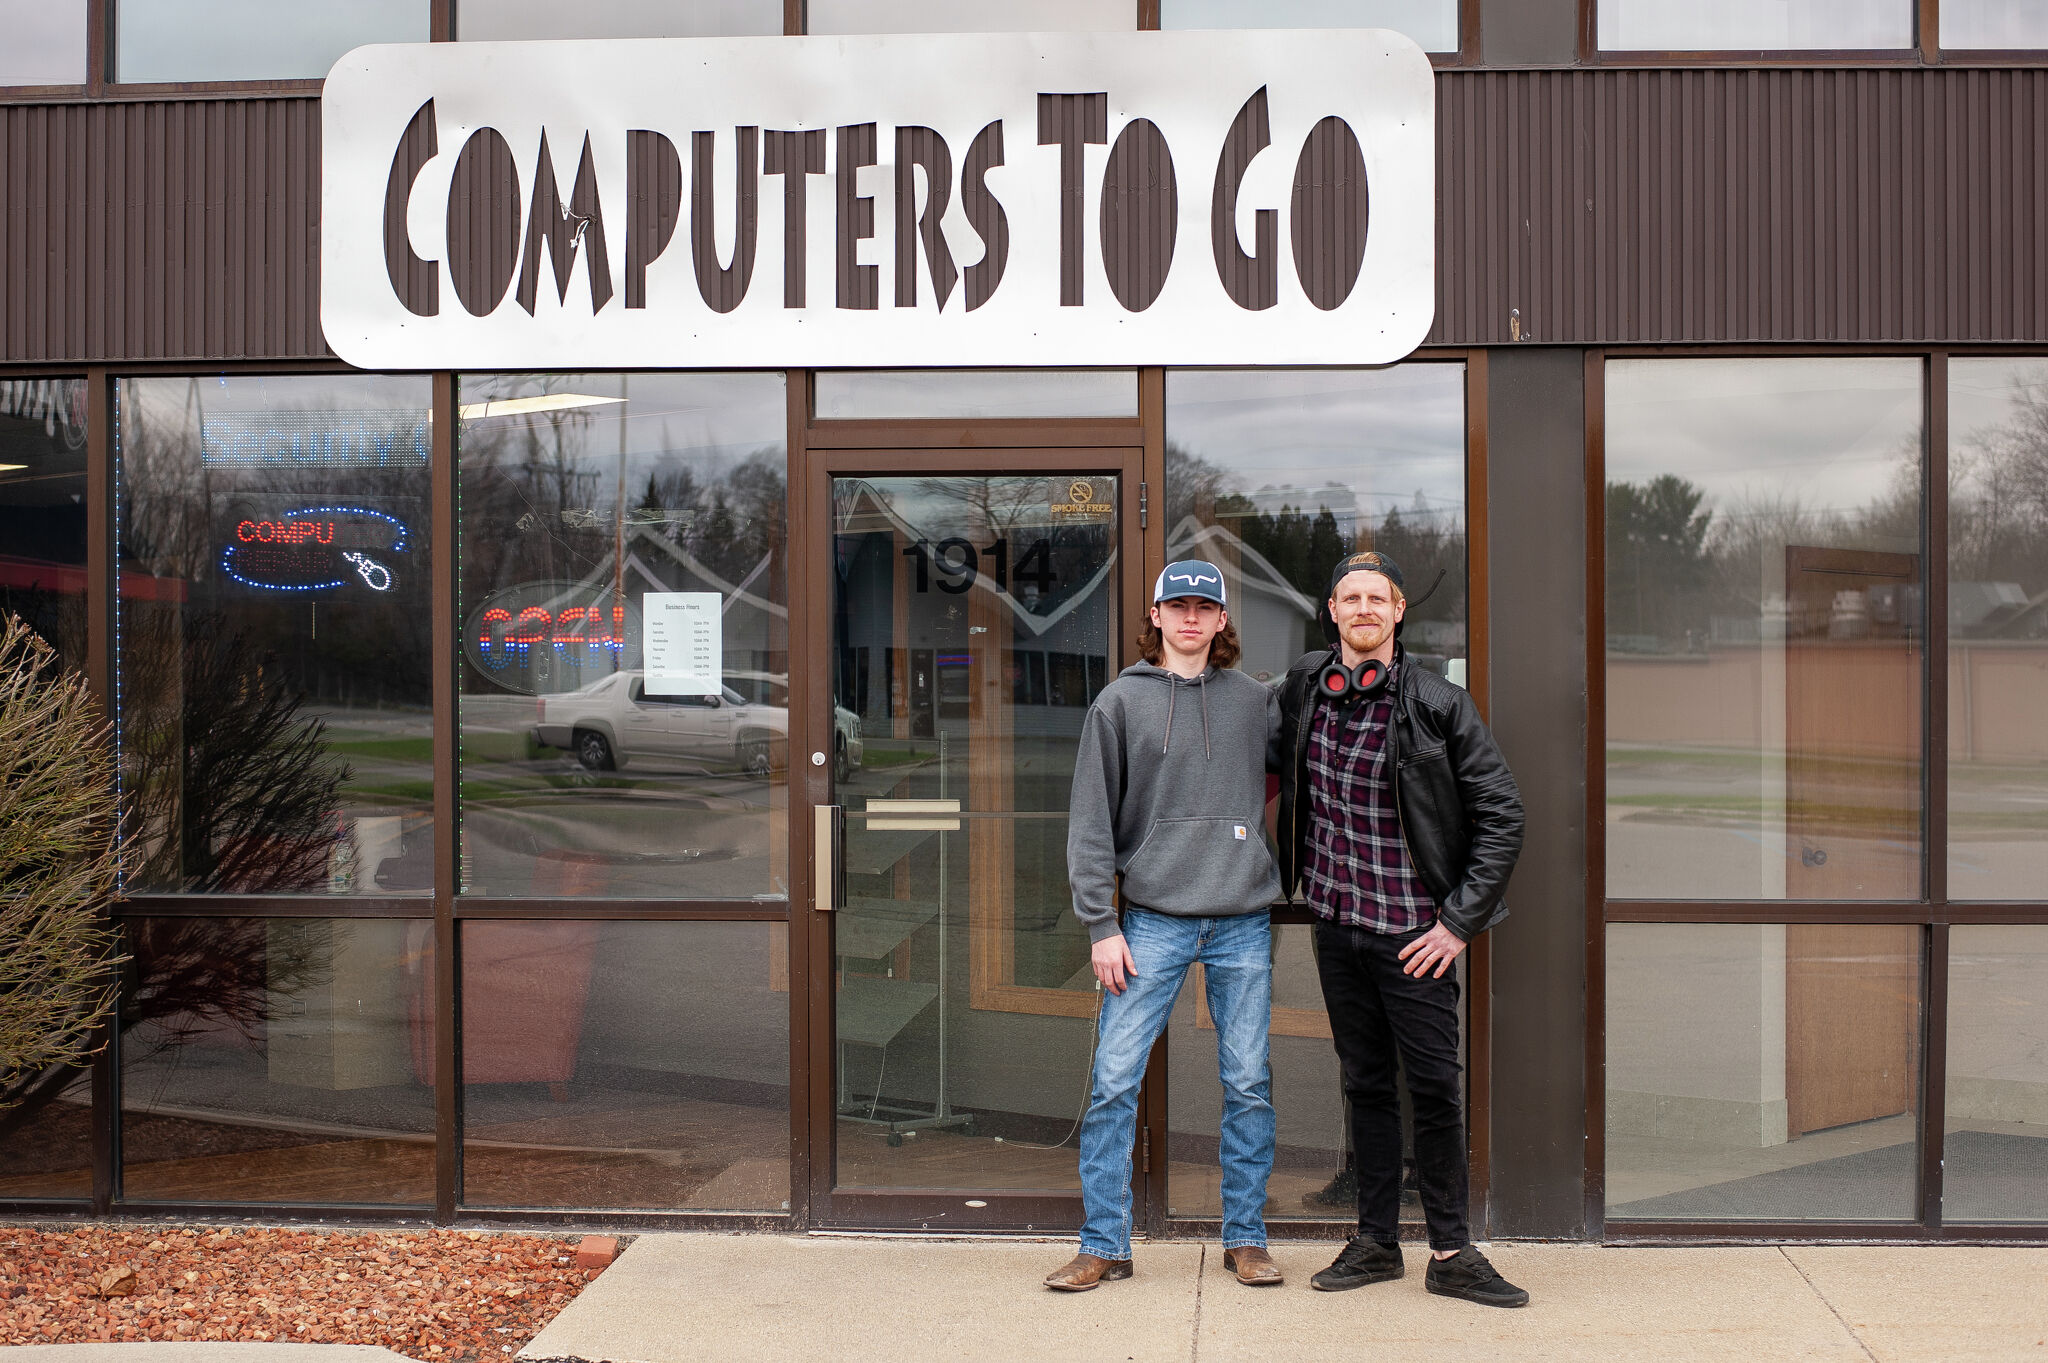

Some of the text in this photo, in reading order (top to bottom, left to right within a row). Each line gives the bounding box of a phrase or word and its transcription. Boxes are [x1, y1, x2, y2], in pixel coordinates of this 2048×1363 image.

[382, 83, 1370, 318] COMPUTERS TO GO
[202, 420, 395, 467] Security
[1051, 504, 1112, 513] SMOKE FREE
[902, 537, 1058, 594] 1914
[479, 606, 625, 670] OPEN
